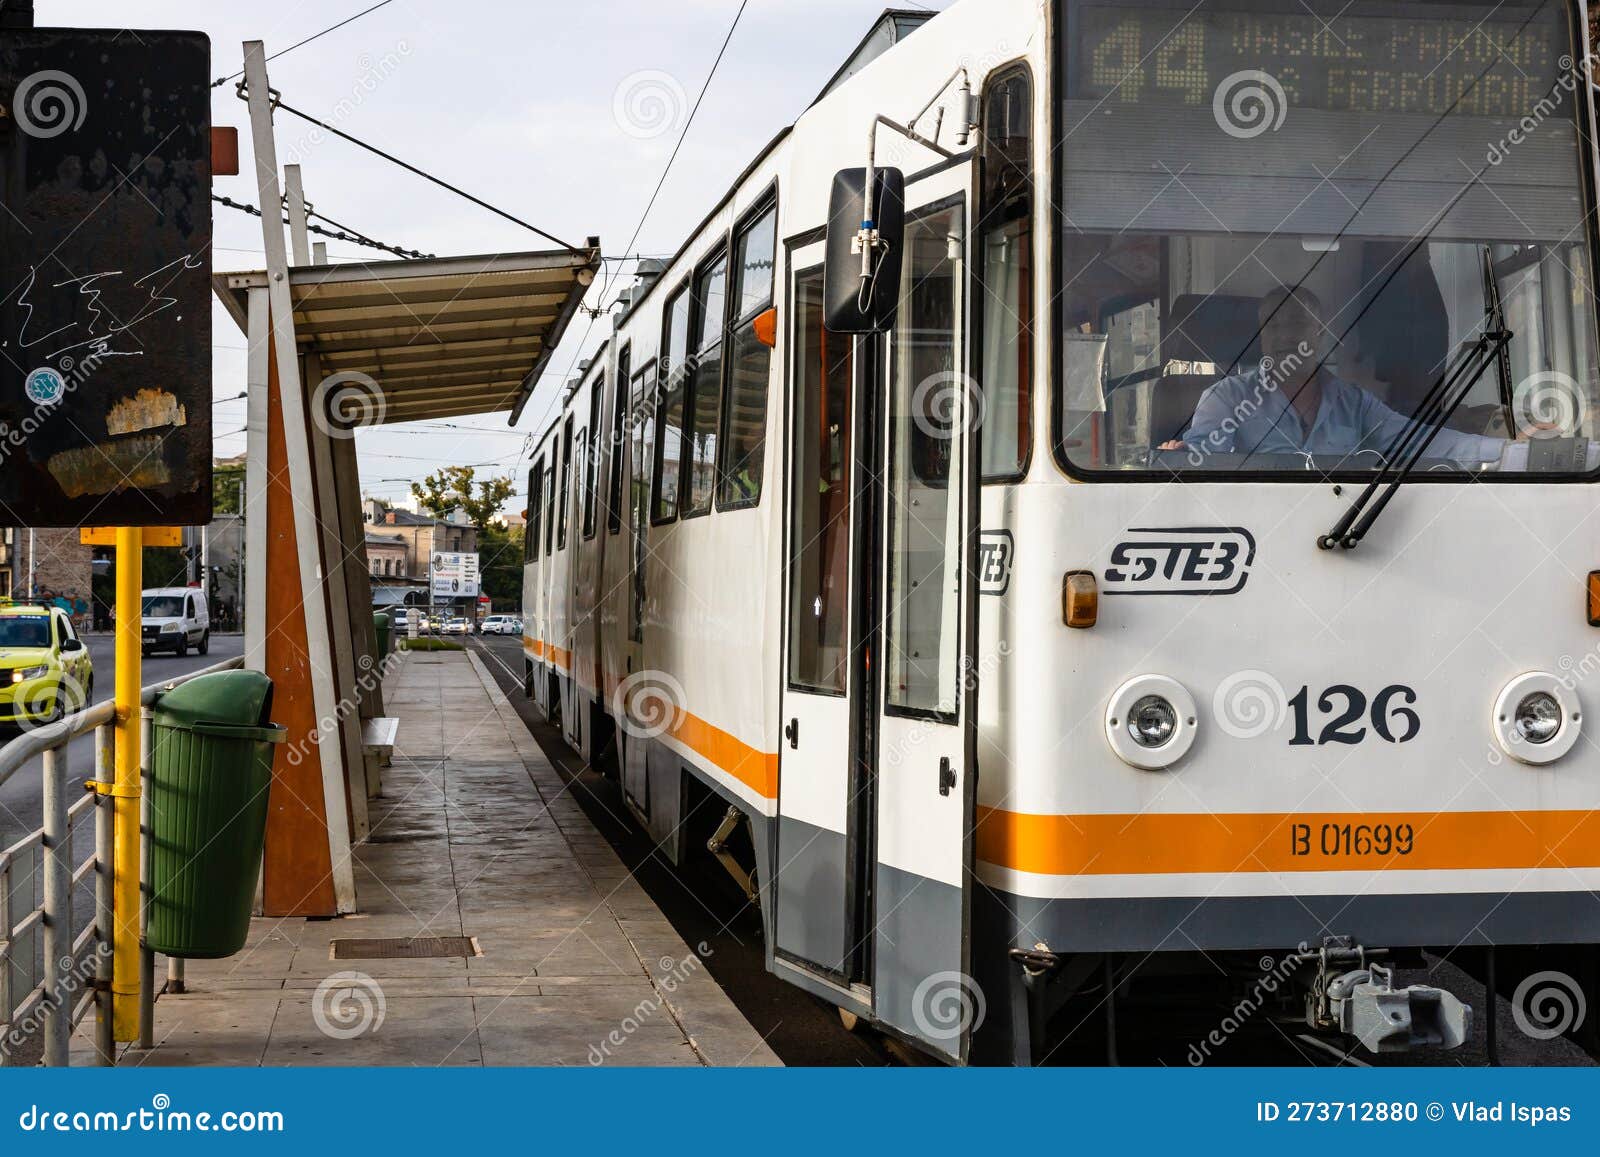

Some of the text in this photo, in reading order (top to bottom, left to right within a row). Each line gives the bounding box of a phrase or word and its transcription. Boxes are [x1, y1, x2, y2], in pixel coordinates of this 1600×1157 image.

[1093, 20, 1208, 104] 44
[1288, 684, 1421, 745] 126
[1291, 823, 1414, 856] B 01699
